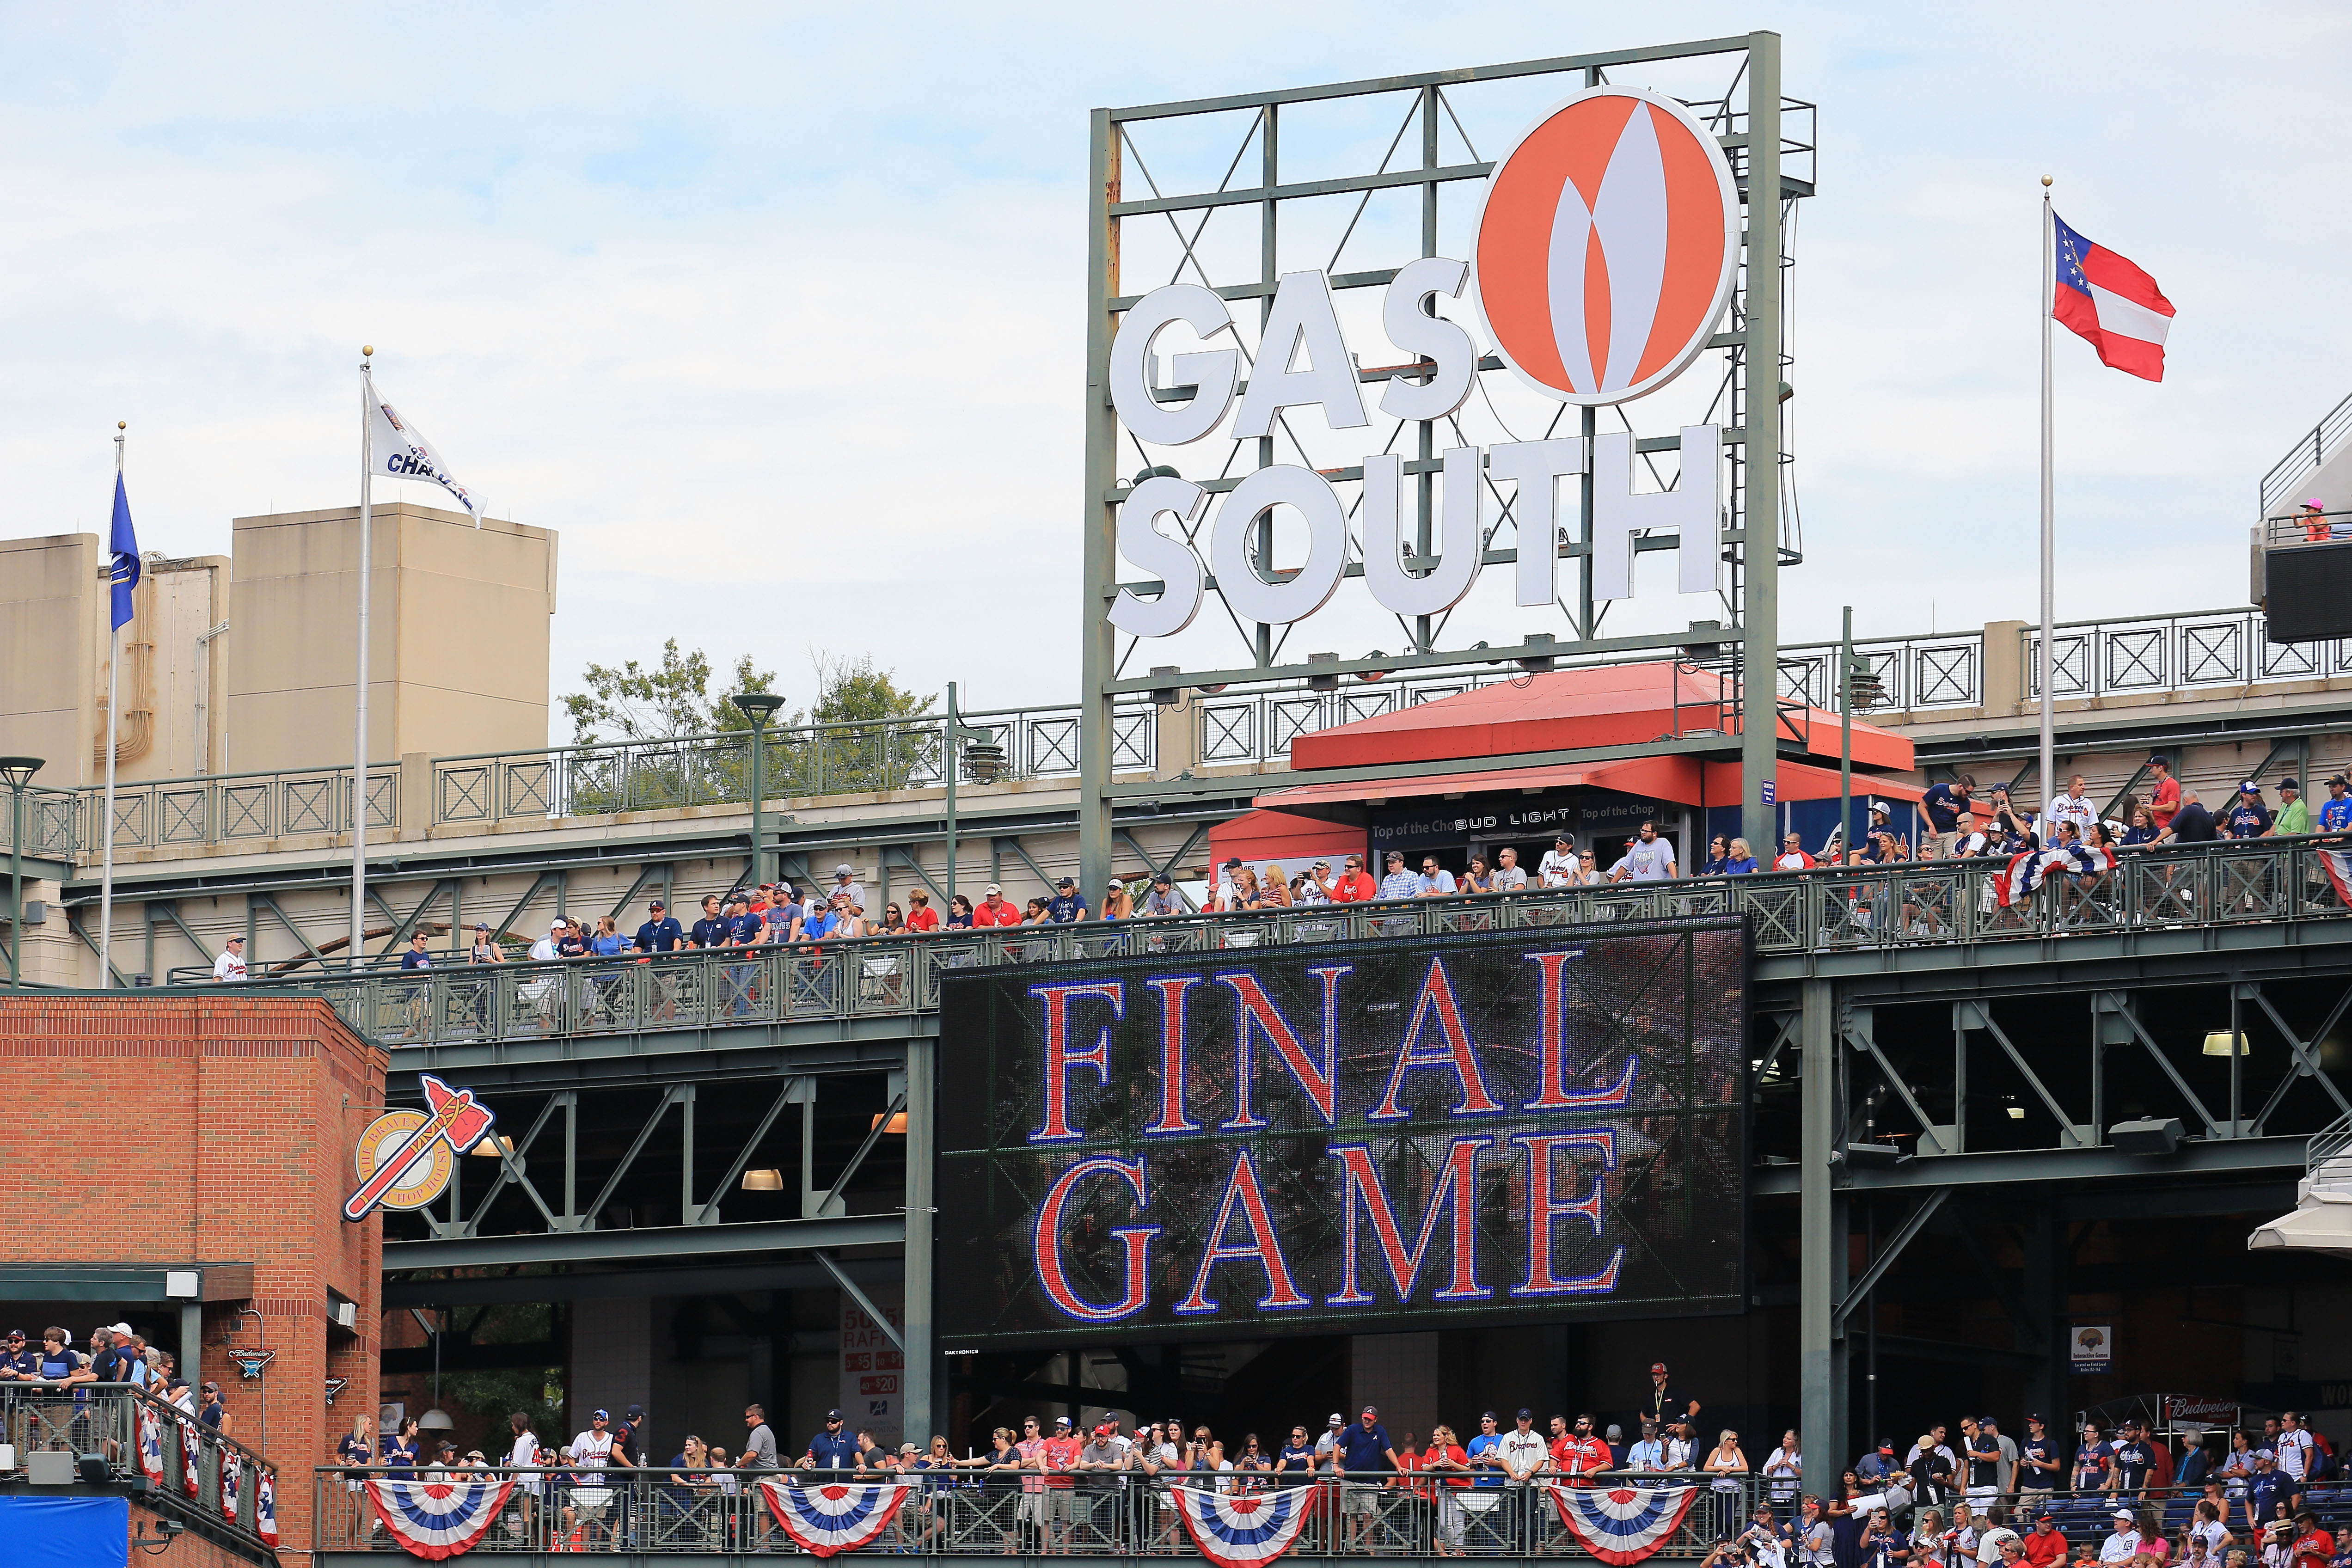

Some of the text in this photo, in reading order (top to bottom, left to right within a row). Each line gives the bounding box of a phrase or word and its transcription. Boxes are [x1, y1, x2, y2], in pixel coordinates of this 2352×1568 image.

[1109, 257, 1478, 445] GAS
[1107, 423, 1721, 637] SOUTH
[1455, 808, 1569, 830] BUD LIGHT
[1581, 804, 1654, 820] Top of the Chop
[1372, 819, 1458, 839] Top of the Cho
[1029, 949, 1638, 1143] FINAL
[361, 1116, 420, 1176] THE BRAVES
[387, 1145, 447, 1202] CHOP HOUSE
[1033, 1128, 1625, 1323] GAME
[858, 1354, 870, 1369] $5
[876, 1377, 894, 1391] $20
[2321, 1385, 2352, 1406] WO
[2170, 1398, 2238, 1418] Budweiser
[615, 1428, 628, 1442] 3
